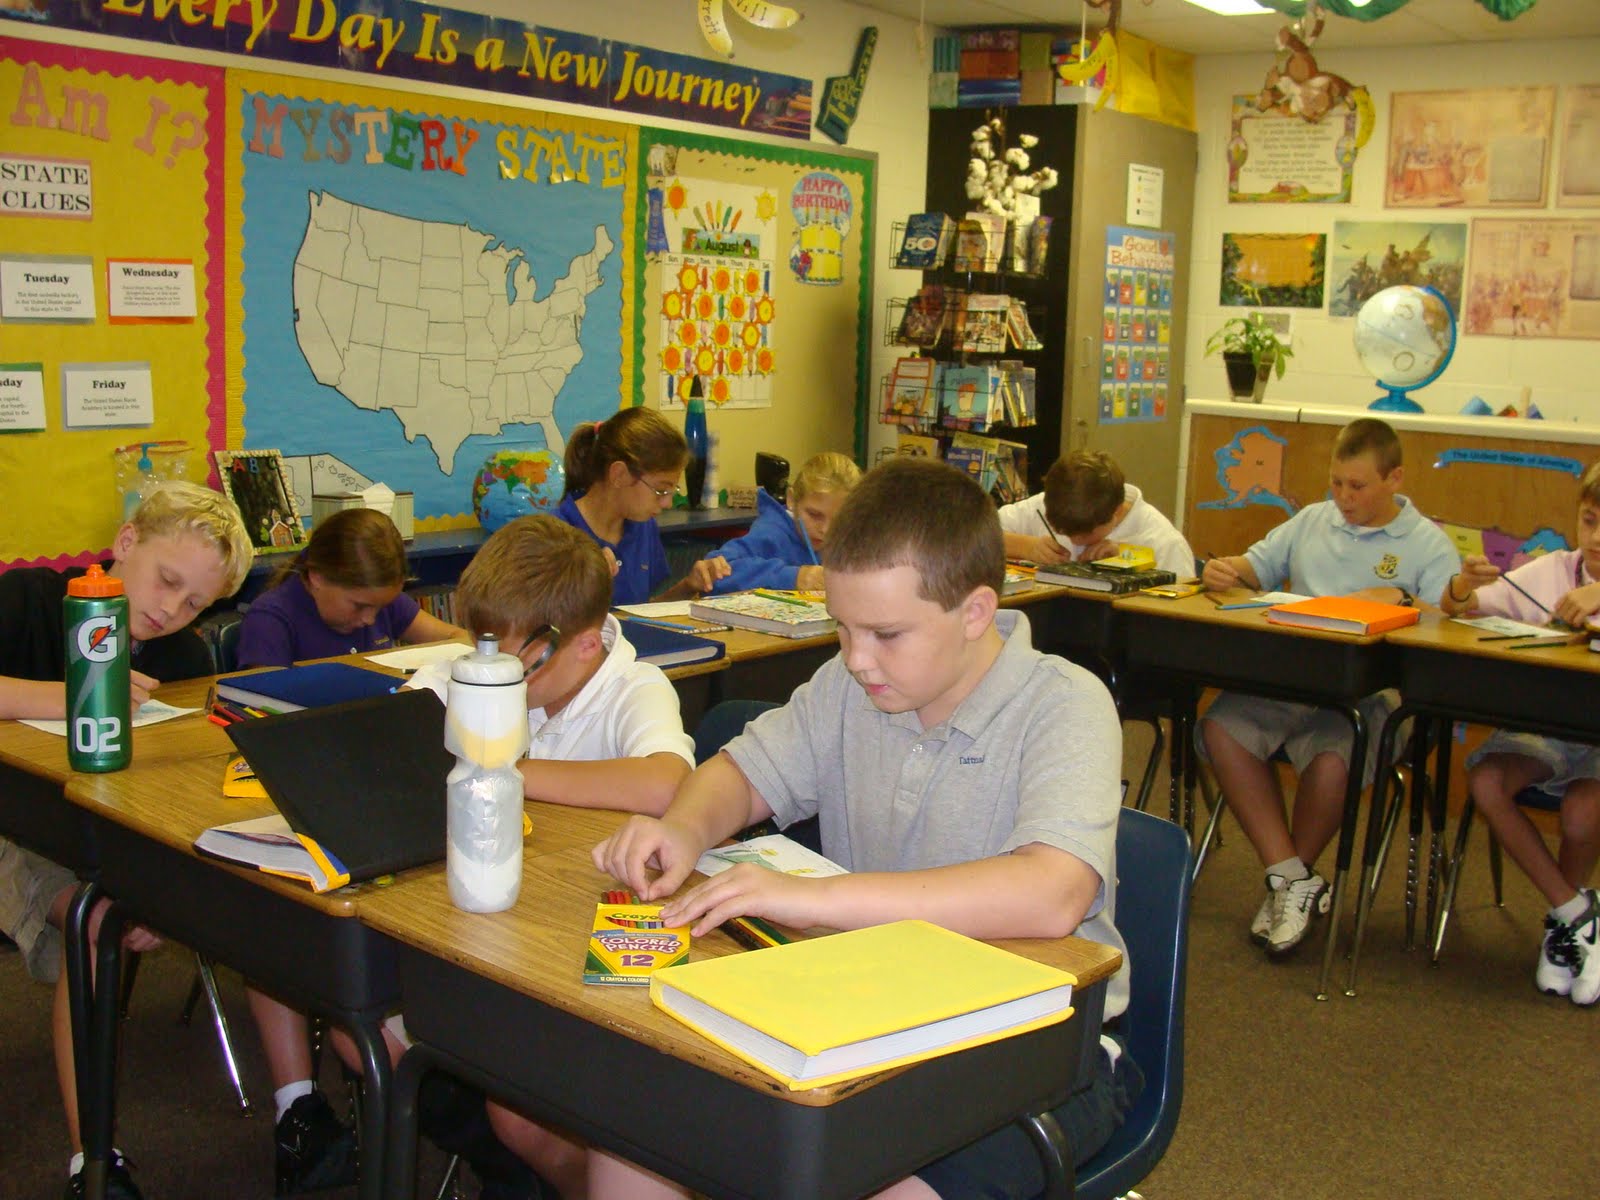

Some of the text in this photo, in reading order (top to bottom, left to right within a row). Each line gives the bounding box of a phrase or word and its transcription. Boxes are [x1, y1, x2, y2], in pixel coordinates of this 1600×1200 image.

[288, 0, 405, 69] Day
[414, 12, 459, 64] Is
[474, 36, 505, 72] a
[516, 31, 607, 90] New
[614, 50, 761, 126] Journey
[10, 62, 110, 142] Am
[247, 97, 626, 189] MYSTERY STATE
[1, 162, 89, 185] STATE
[802, 177, 844, 195] HAPPY
[2, 190, 90, 212] CLUES
[792, 194, 849, 213] BIRTHDAY
[705, 238, 739, 255] August
[1125, 236, 1158, 254] Good
[24, 273, 70, 285] Tuesday
[122, 267, 180, 279] Wednesday
[93, 380, 126, 390] Friday
[77, 615, 118, 663] G
[75, 716, 121, 753] 02
[600, 937, 682, 947] COLORED
[605, 943, 677, 954] PENCILS
[620, 954, 655, 967] 12
